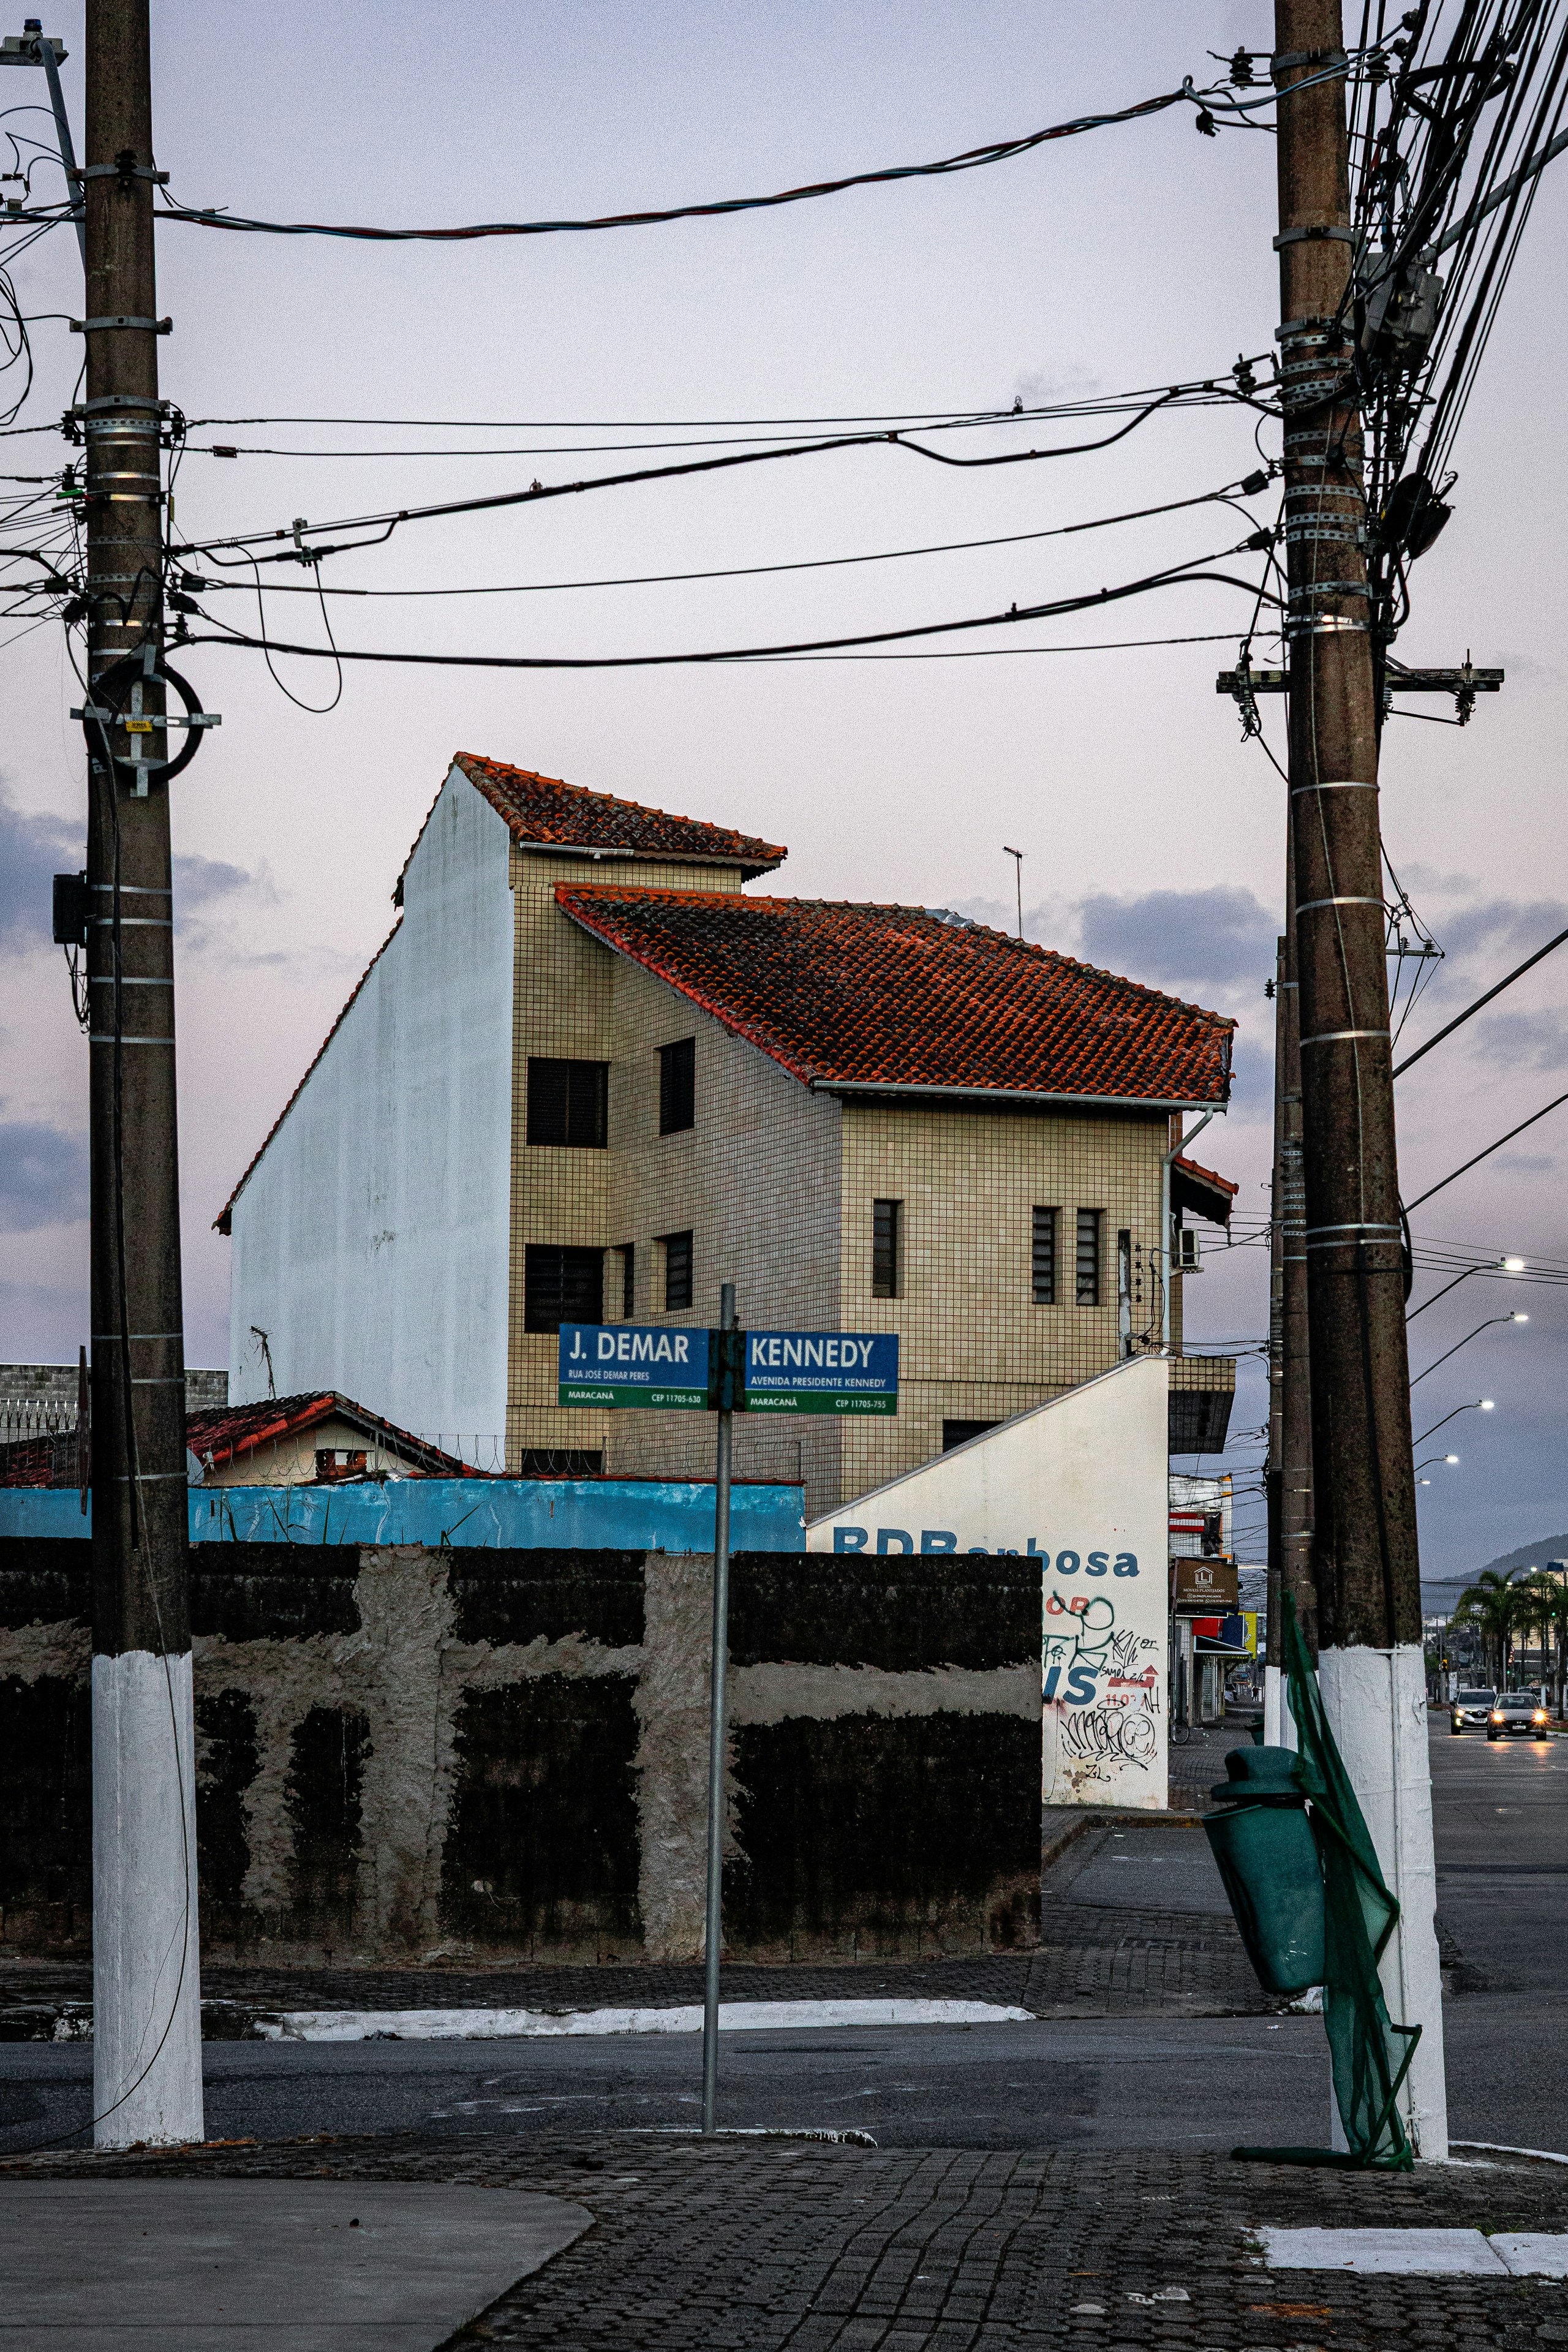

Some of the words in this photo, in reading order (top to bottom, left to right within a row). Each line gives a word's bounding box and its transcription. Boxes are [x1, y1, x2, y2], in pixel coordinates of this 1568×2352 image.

[569, 1332, 587, 1359] J.
[598, 1332, 688, 1363] DEMAR
[752, 1338, 874, 1368] KENNEDY
[568, 1370, 582, 1378] RUA
[584, 1368, 601, 1379] JOSÉ
[603, 1371, 628, 1379] DEMAR
[630, 1371, 649, 1381] PERES
[751, 1376, 790, 1386] AVENIDA
[793, 1378, 842, 1387] PRESIDENTE
[845, 1379, 886, 1388] KENNEDY
[568, 1390, 614, 1400] MARACANÁ
[666, 1395, 701, 1403] 11705-630
